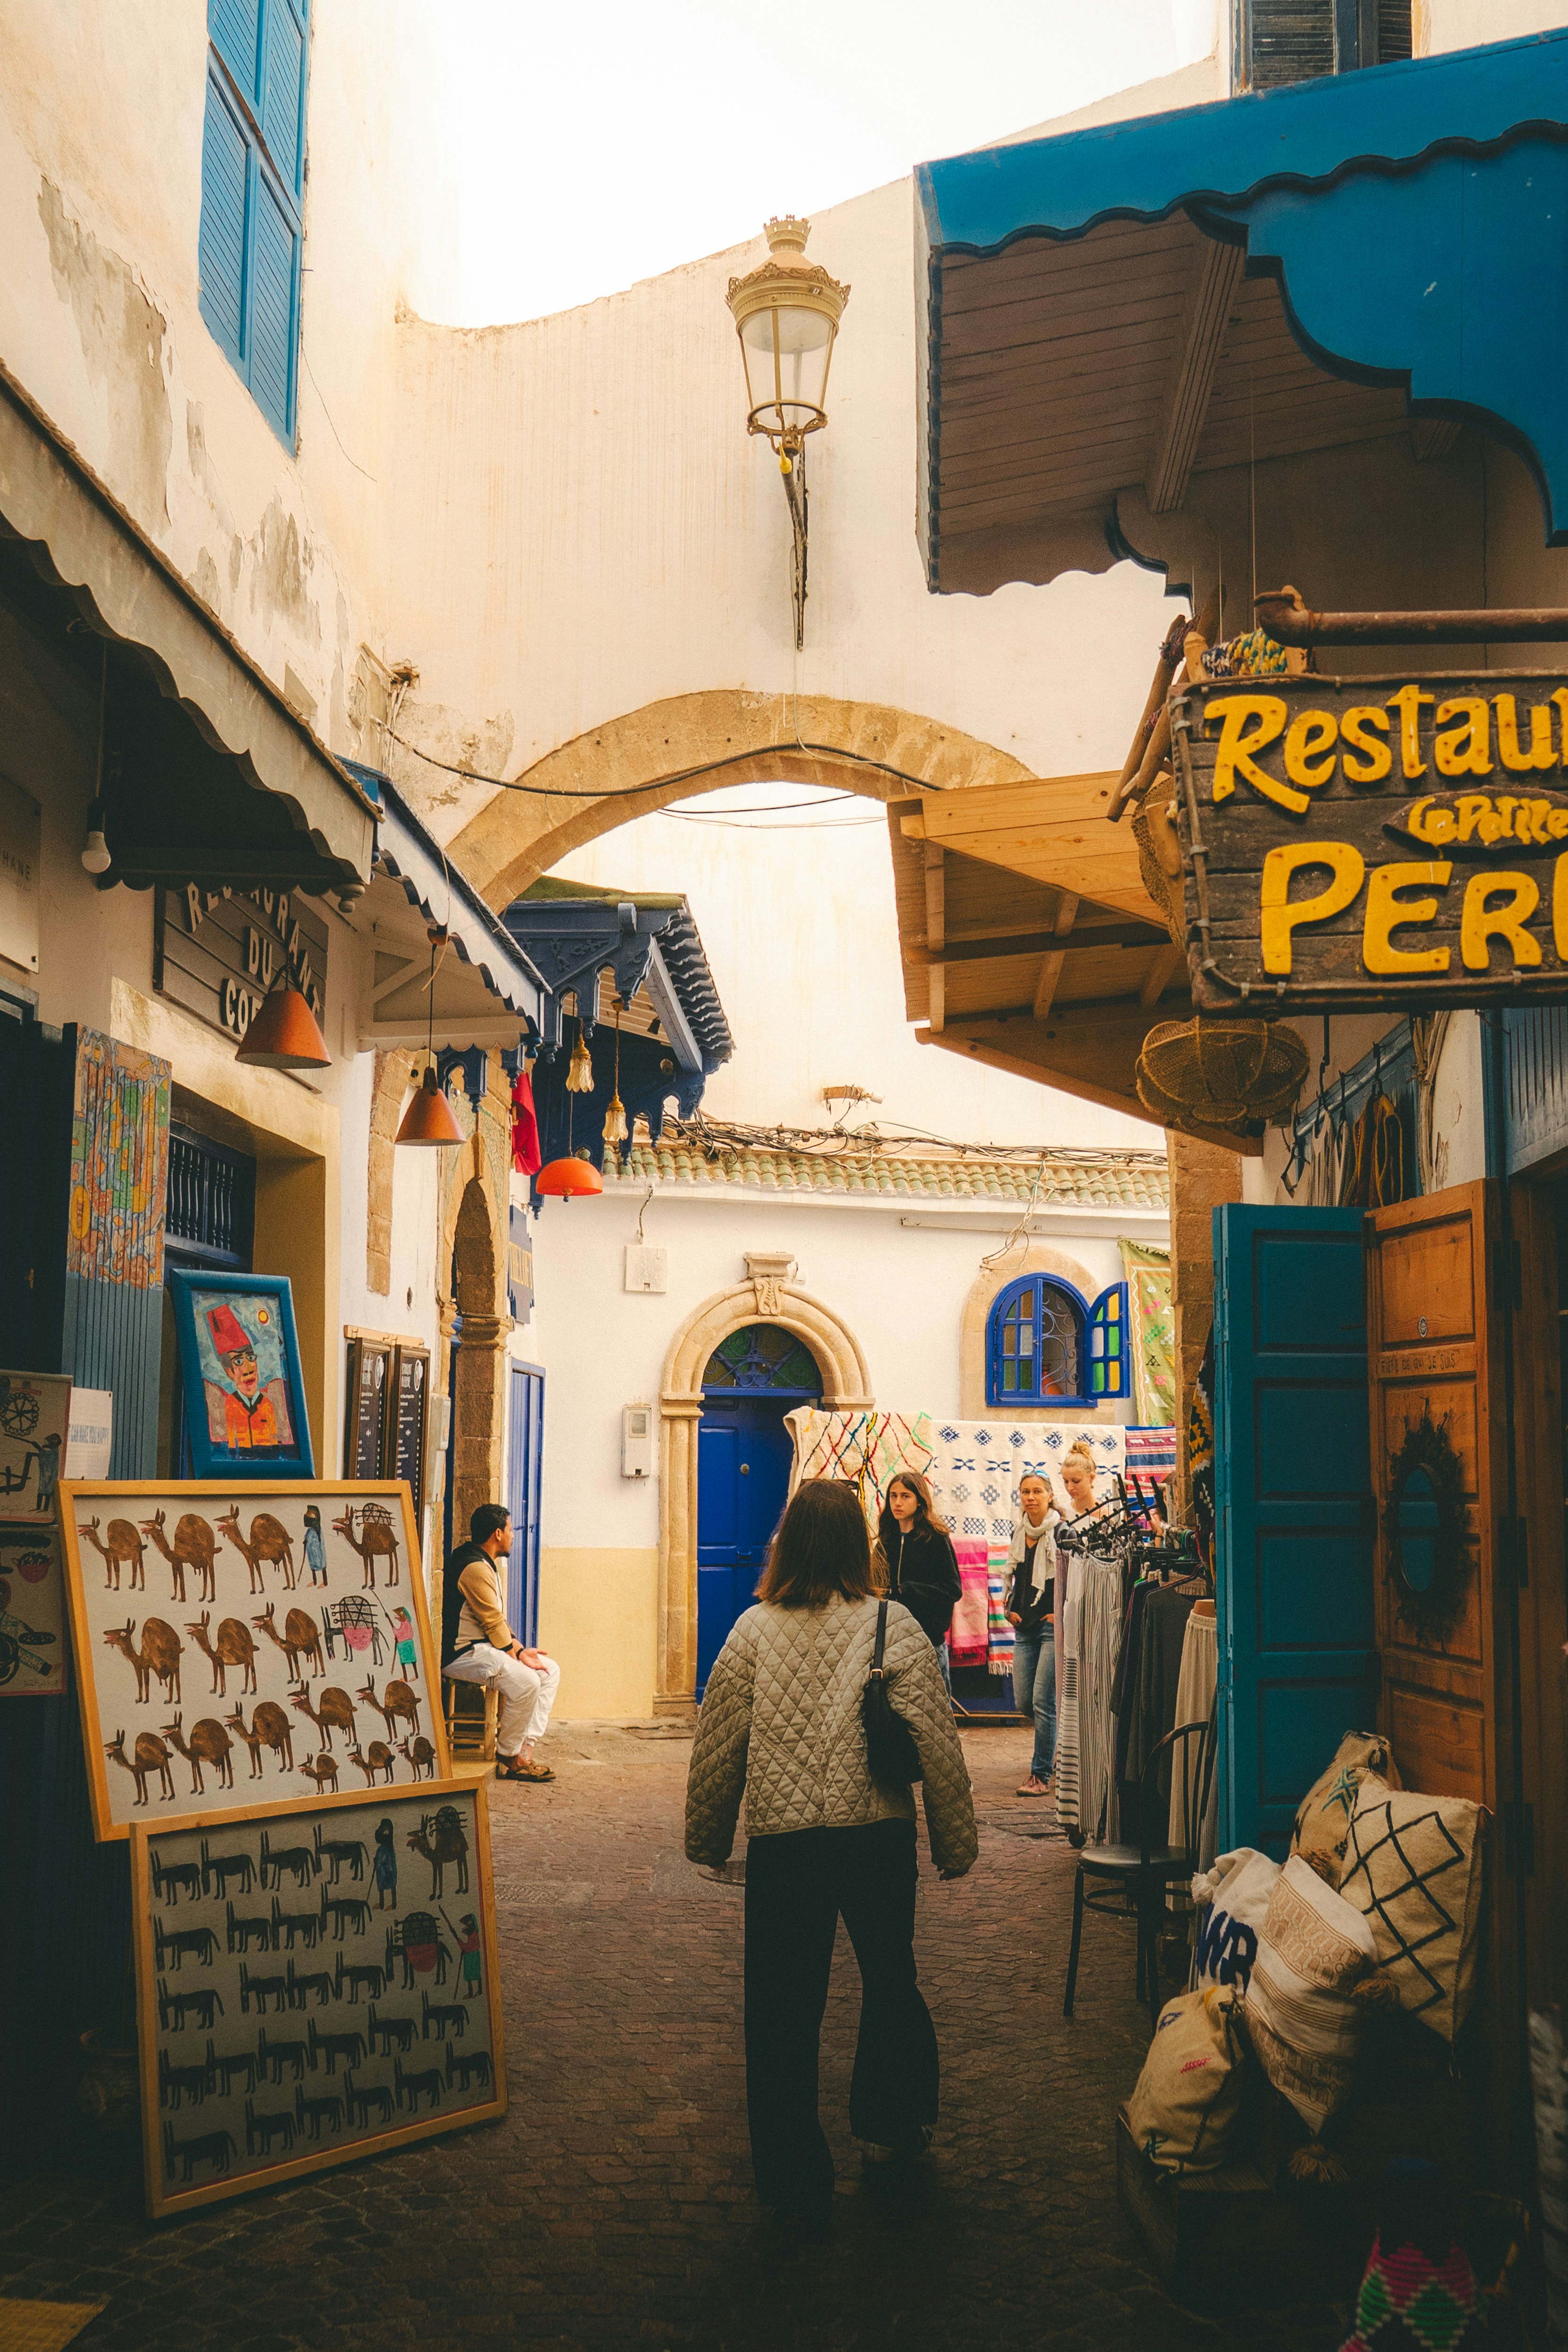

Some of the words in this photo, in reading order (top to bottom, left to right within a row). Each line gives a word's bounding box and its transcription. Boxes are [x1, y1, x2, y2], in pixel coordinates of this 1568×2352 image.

[249, 926, 272, 986] DU
[1428, 1355, 1436, 1370] JE
[1440, 1352, 1456, 1370] SUIS
